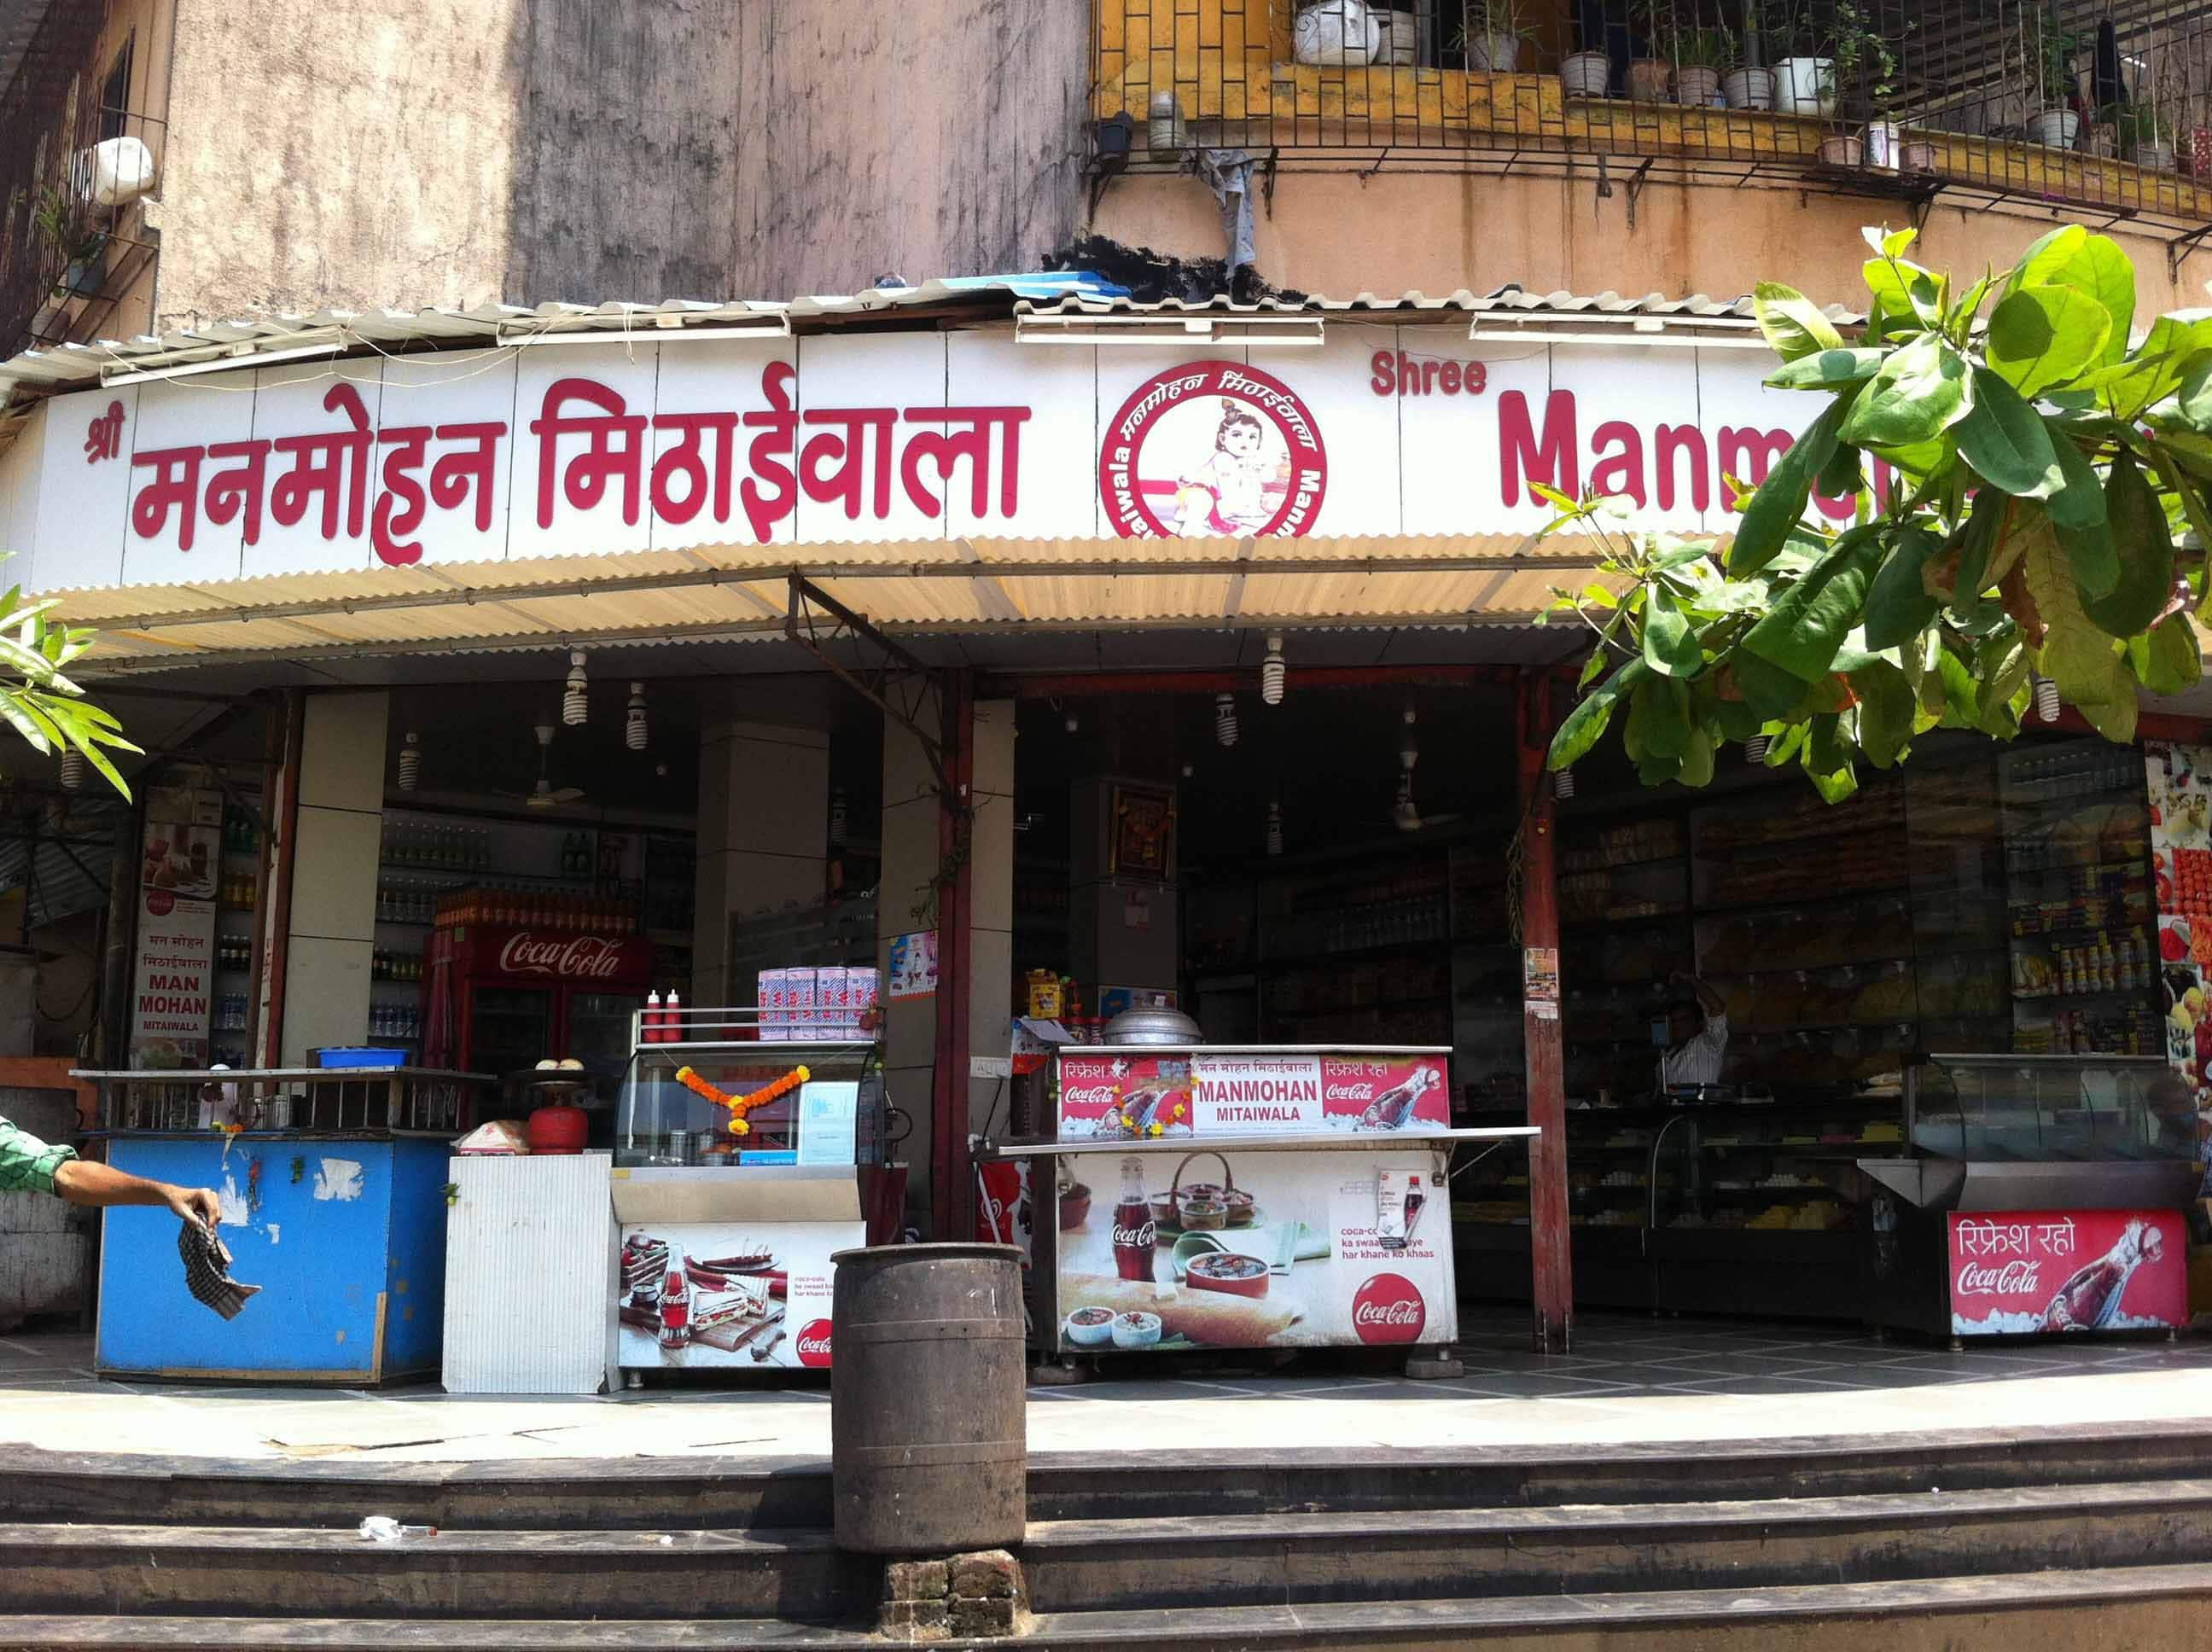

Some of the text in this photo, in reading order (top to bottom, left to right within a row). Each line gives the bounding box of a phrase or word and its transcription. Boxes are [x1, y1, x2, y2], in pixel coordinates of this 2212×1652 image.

[1371, 350, 1487, 397] Shree
[1120, 369, 1318, 452] मनमोहन मिठाईवाला
[84, 360, 1033, 567] श्री मनमोहन मिठाईवाला
[499, 931, 624, 977] Coca-Cola
[148, 974, 200, 992] MAN
[139, 996, 206, 1015] MOHAN
[143, 1021, 199, 1032] MITAIWALA
[1065, 1085, 1114, 1103] Coca-Cola
[1198, 1079, 1318, 1102] MANMOHAN
[1326, 1083, 1373, 1100] Coca-Cola
[1216, 1107, 1301, 1121] MITAIWALA
[1342, 1238, 1353, 1247] ka
[1356, 1238, 1382, 1248] swaa
[1956, 1217, 2075, 1256] रिफ्रेश रहो
[1342, 1250, 1359, 1259] har
[1360, 1249, 1390, 1259] khane
[1406, 1249, 1434, 1258] khaas
[1958, 1260, 2042, 1295] Coca-Cola
[1355, 1300, 1421, 1325] Coca-Cola
